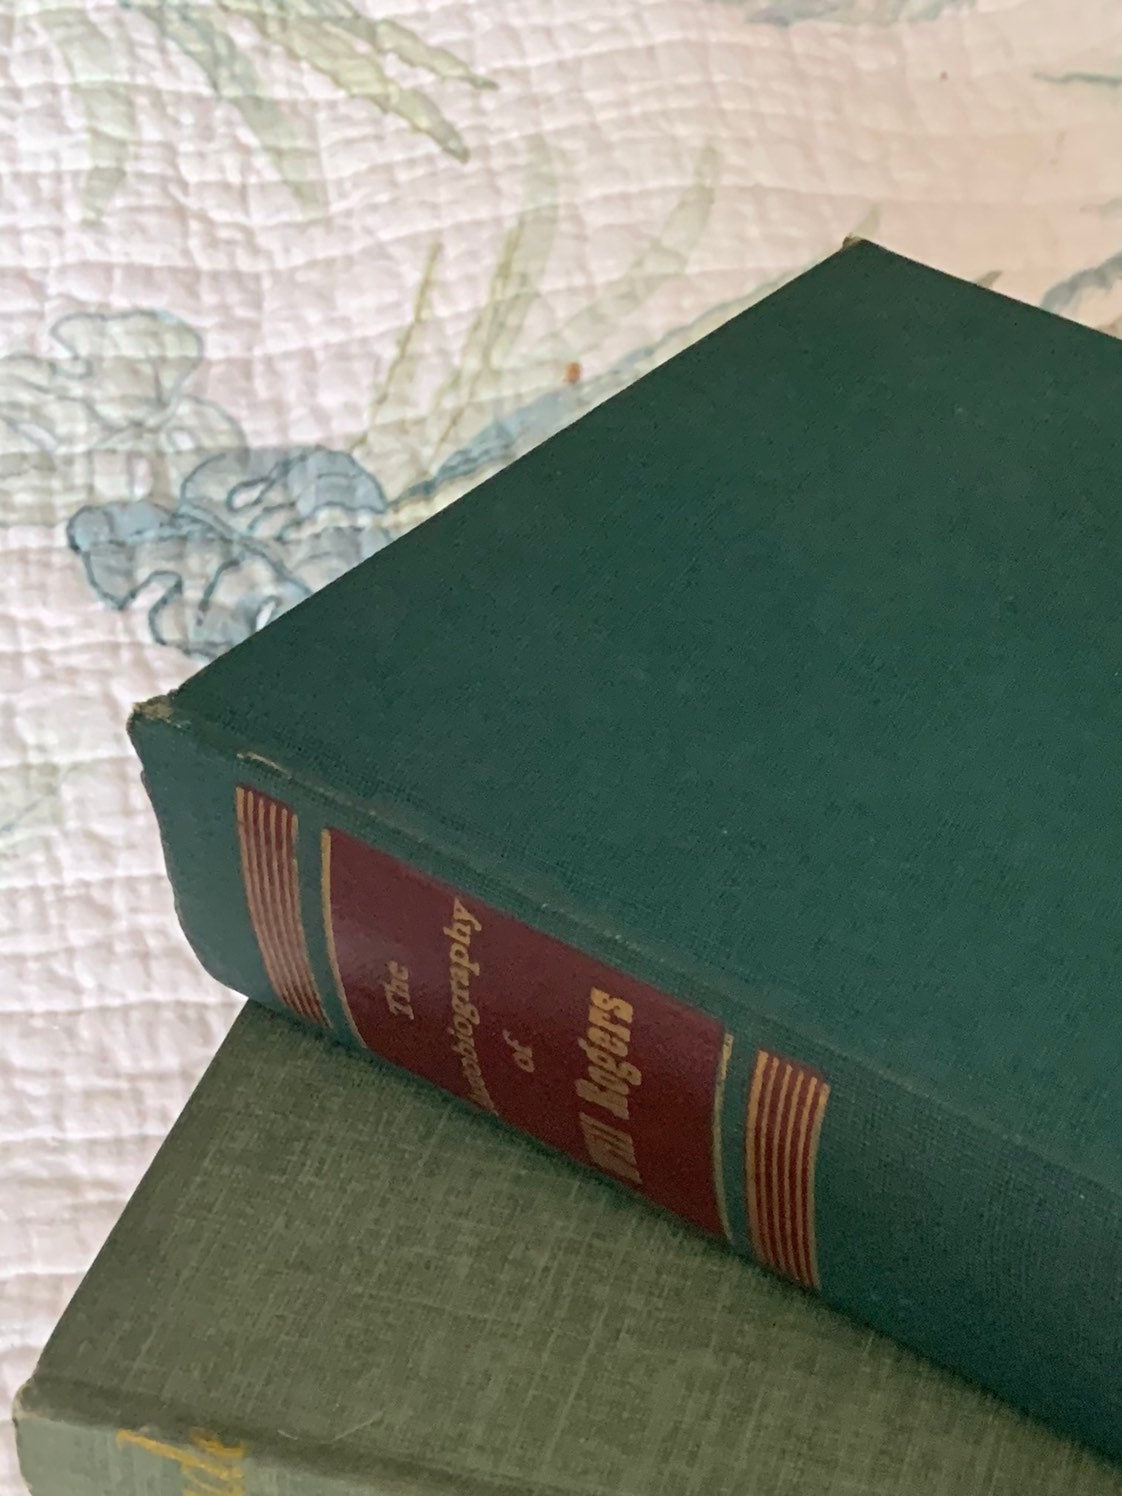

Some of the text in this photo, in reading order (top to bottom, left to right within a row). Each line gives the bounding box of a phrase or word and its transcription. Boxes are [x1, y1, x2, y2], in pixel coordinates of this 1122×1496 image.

[384, 959, 414, 1020] The
[502, 1028, 535, 1073] of
[575, 986, 642, 1120] Rogers
